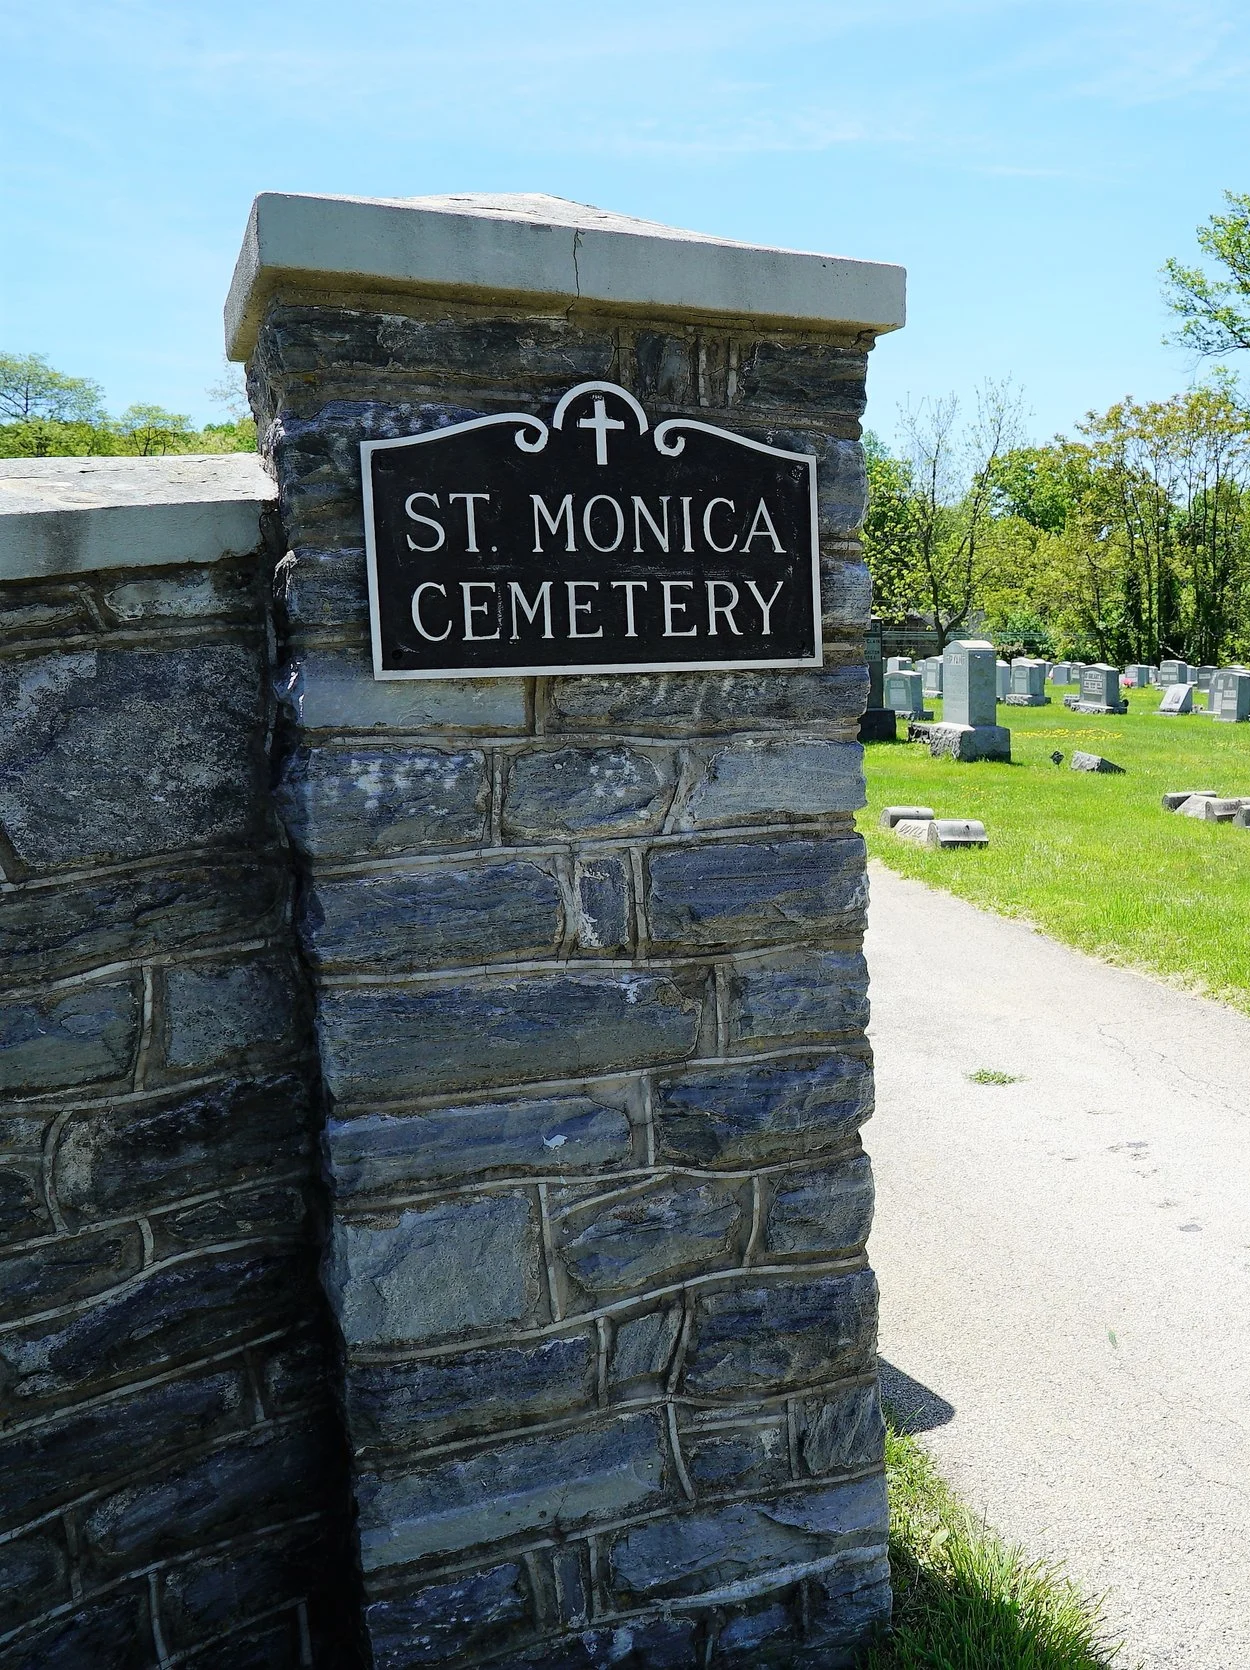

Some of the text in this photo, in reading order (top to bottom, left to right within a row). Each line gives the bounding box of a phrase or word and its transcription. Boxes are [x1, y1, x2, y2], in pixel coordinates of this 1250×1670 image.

[404, 492, 788, 553] ST. MONICA
[411, 580, 785, 642] CEMETERY
